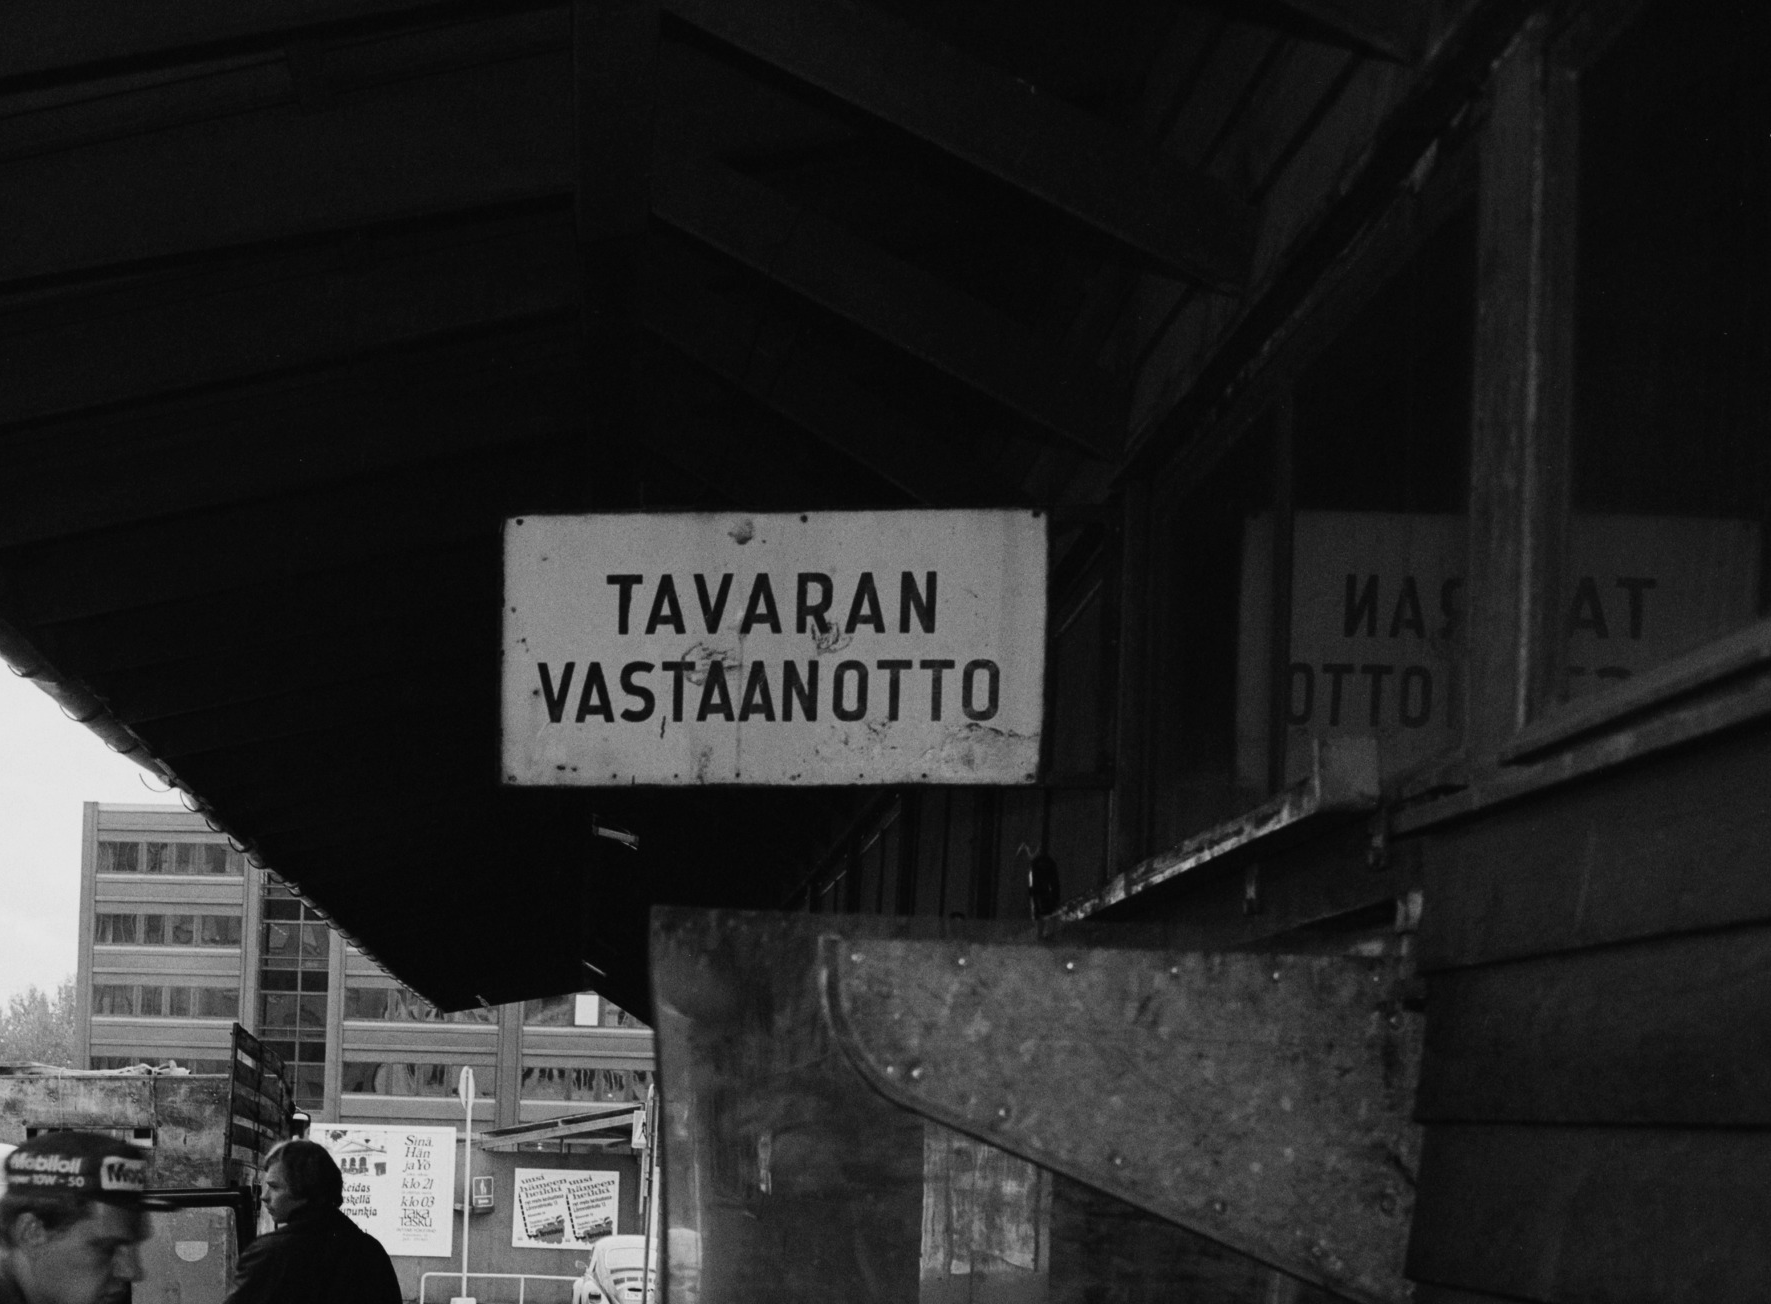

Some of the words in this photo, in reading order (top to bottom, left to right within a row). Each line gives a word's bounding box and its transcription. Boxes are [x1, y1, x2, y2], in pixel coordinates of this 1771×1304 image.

[606, 571, 938, 635] TAVARAN
[537, 659, 1001, 724] VASTAANOTTO
[405, 1146, 431, 1158] Hän
